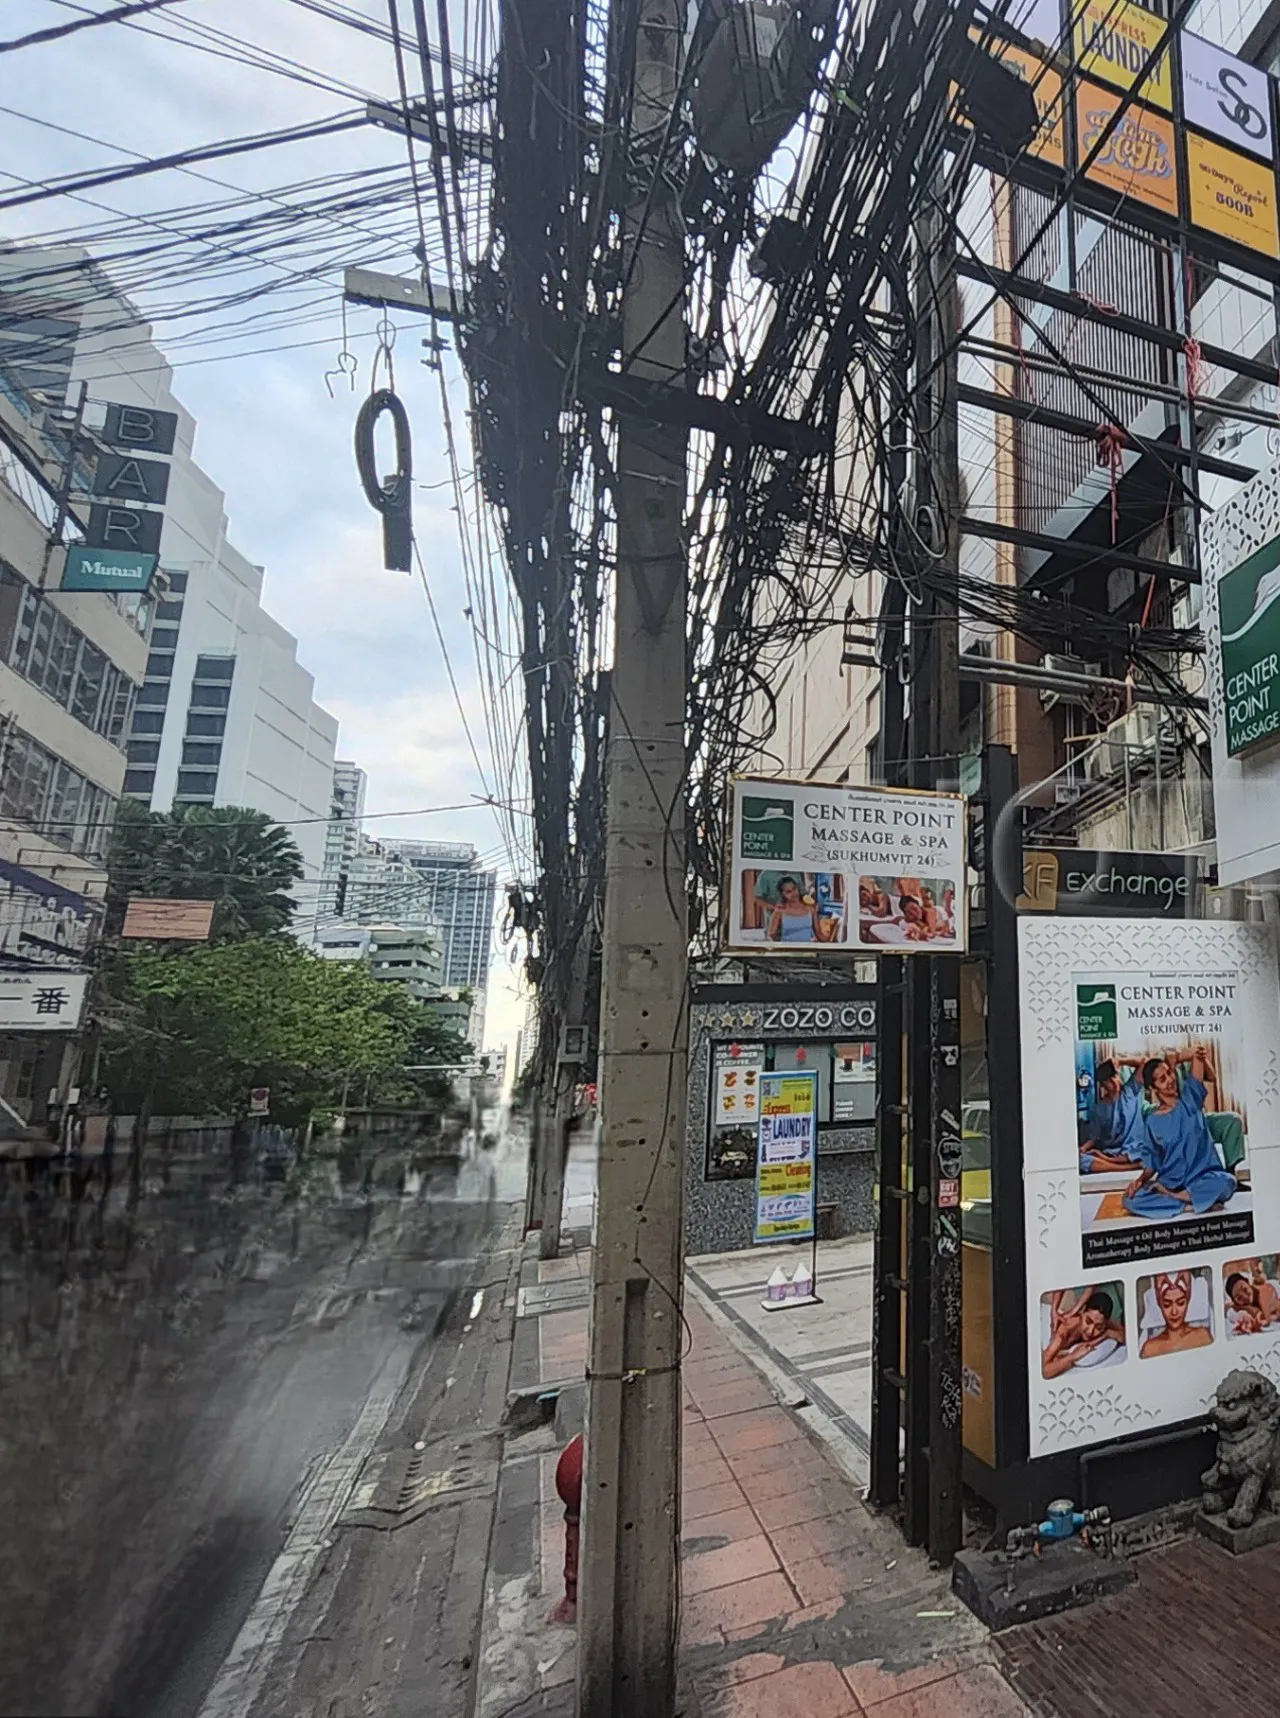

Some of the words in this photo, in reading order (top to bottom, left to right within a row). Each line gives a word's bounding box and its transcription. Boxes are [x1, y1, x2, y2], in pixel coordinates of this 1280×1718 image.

[103, 409, 155, 545] BAR
[81, 560, 143, 578] Mutual
[1226, 653, 1279, 701] CENTER
[1229, 686, 1271, 728] POINT
[1230, 713, 1280, 750] MASSAGE
[803, 803, 888, 825] CENTER
[892, 810, 955, 829] POINT
[743, 832, 775, 842] CENTER
[743, 841, 769, 850] POINT
[811, 827, 894, 845] MASSAGE
[900, 834, 913, 847] &
[919, 835, 948, 849] SPA
[827, 849, 913, 864] (SUKHUMVIT
[1120, 986, 1184, 1000] CENTER
[1188, 985, 1236, 999] POINT
[763, 1007, 832, 1028] ZOZO
[1128, 1006, 1191, 1019] MASSAGE
[1195, 1007, 1204, 1017] &
[1209, 1005, 1232, 1017] SPA
[1140, 1023, 1205, 1035] (SUKHUMVIT
[773, 1117, 811, 1139] LAUNDRY
[1088, 1239, 1103, 1248] Thai
[1106, 1235, 1134, 1246] Massage
[1155, 1230, 1171, 1240] Body
[1173, 1226, 1200, 1236] Massage
[1222, 1219, 1248, 1229] Massage
[1086, 1249, 1132, 1261] Aromatherapy
[1134, 1244, 1151, 1254] Body
[1153, 1239, 1180, 1250] Massage
[1188, 1236, 1201, 1245] Thai
[1226, 1230, 1251, 1240] Massage
